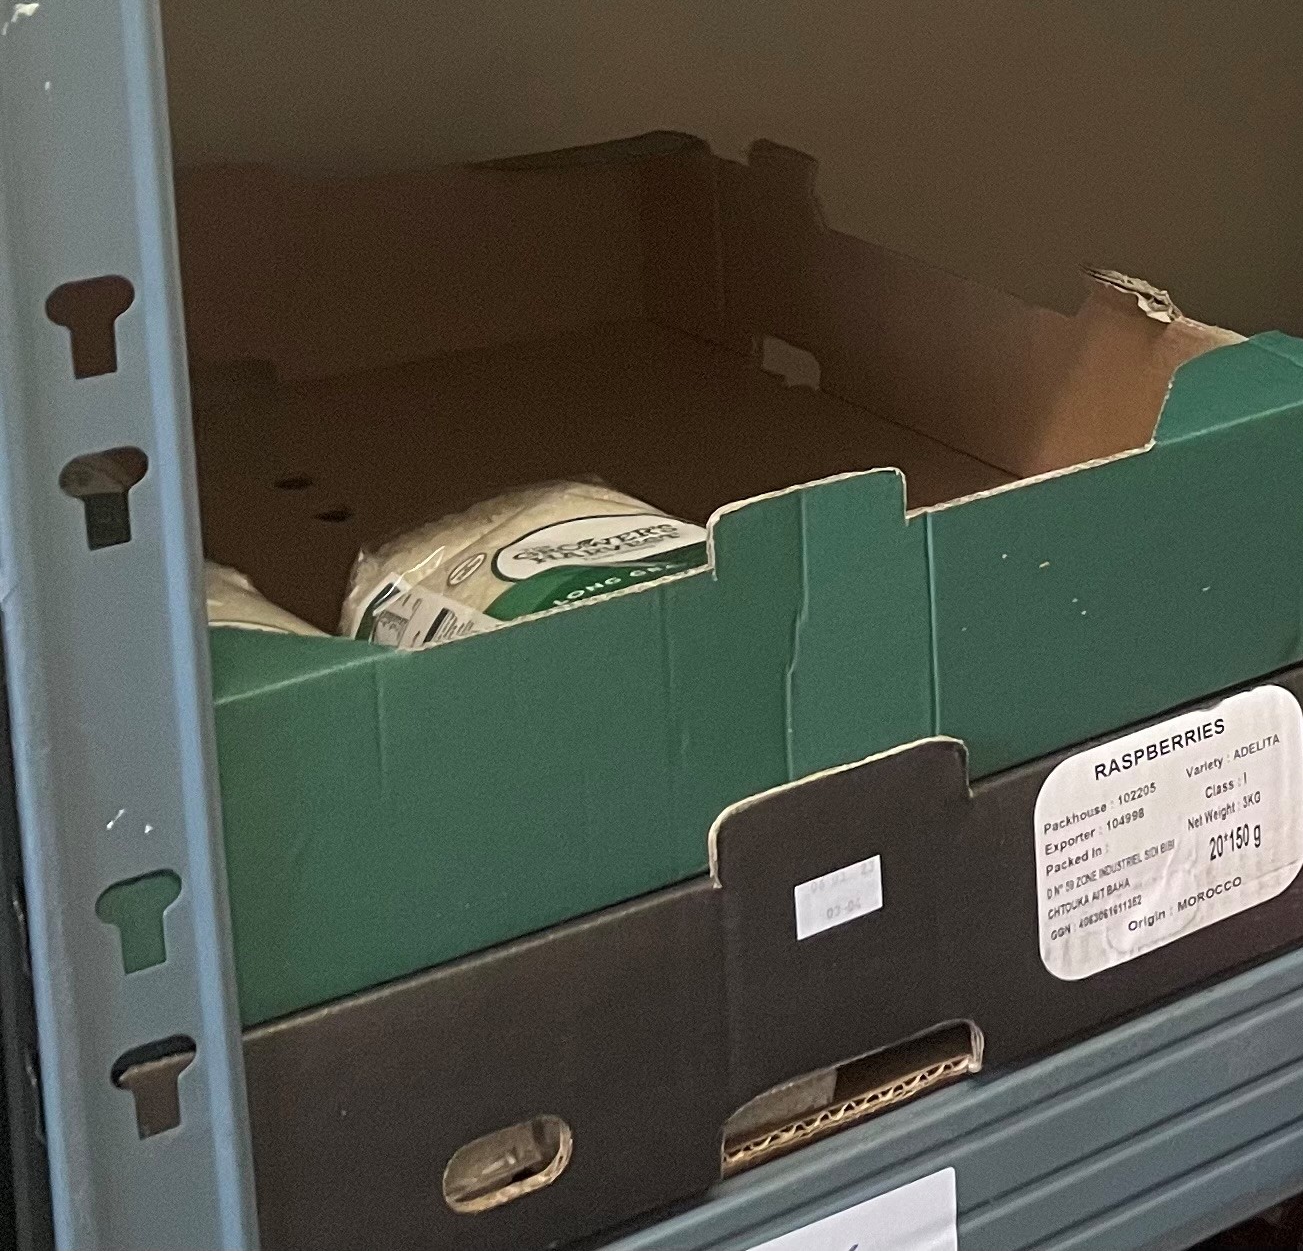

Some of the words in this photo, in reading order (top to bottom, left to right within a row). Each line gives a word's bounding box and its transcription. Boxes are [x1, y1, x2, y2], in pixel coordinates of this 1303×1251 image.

[553, 576, 622, 606] LONG
[1095, 718, 1225, 781] RASPBERRIES
[1186, 757, 1224, 779] Variety
[1233, 733, 1281, 760] ADELITA
[1043, 802, 1107, 834] Packhouse
[1118, 782, 1157, 805] 102205
[1205, 780, 1235, 799] Class
[1045, 827, 1096, 856] Exporter
[1106, 807, 1145, 832] 104998
[1187, 815, 1203, 831] Net
[1205, 801, 1236, 825] Weight
[1253, 829, 1262, 850] g
[1045, 850, 1088, 876] Packed
[1128, 911, 1166, 933] Origin
[1177, 876, 1243, 913] MOROCCO
